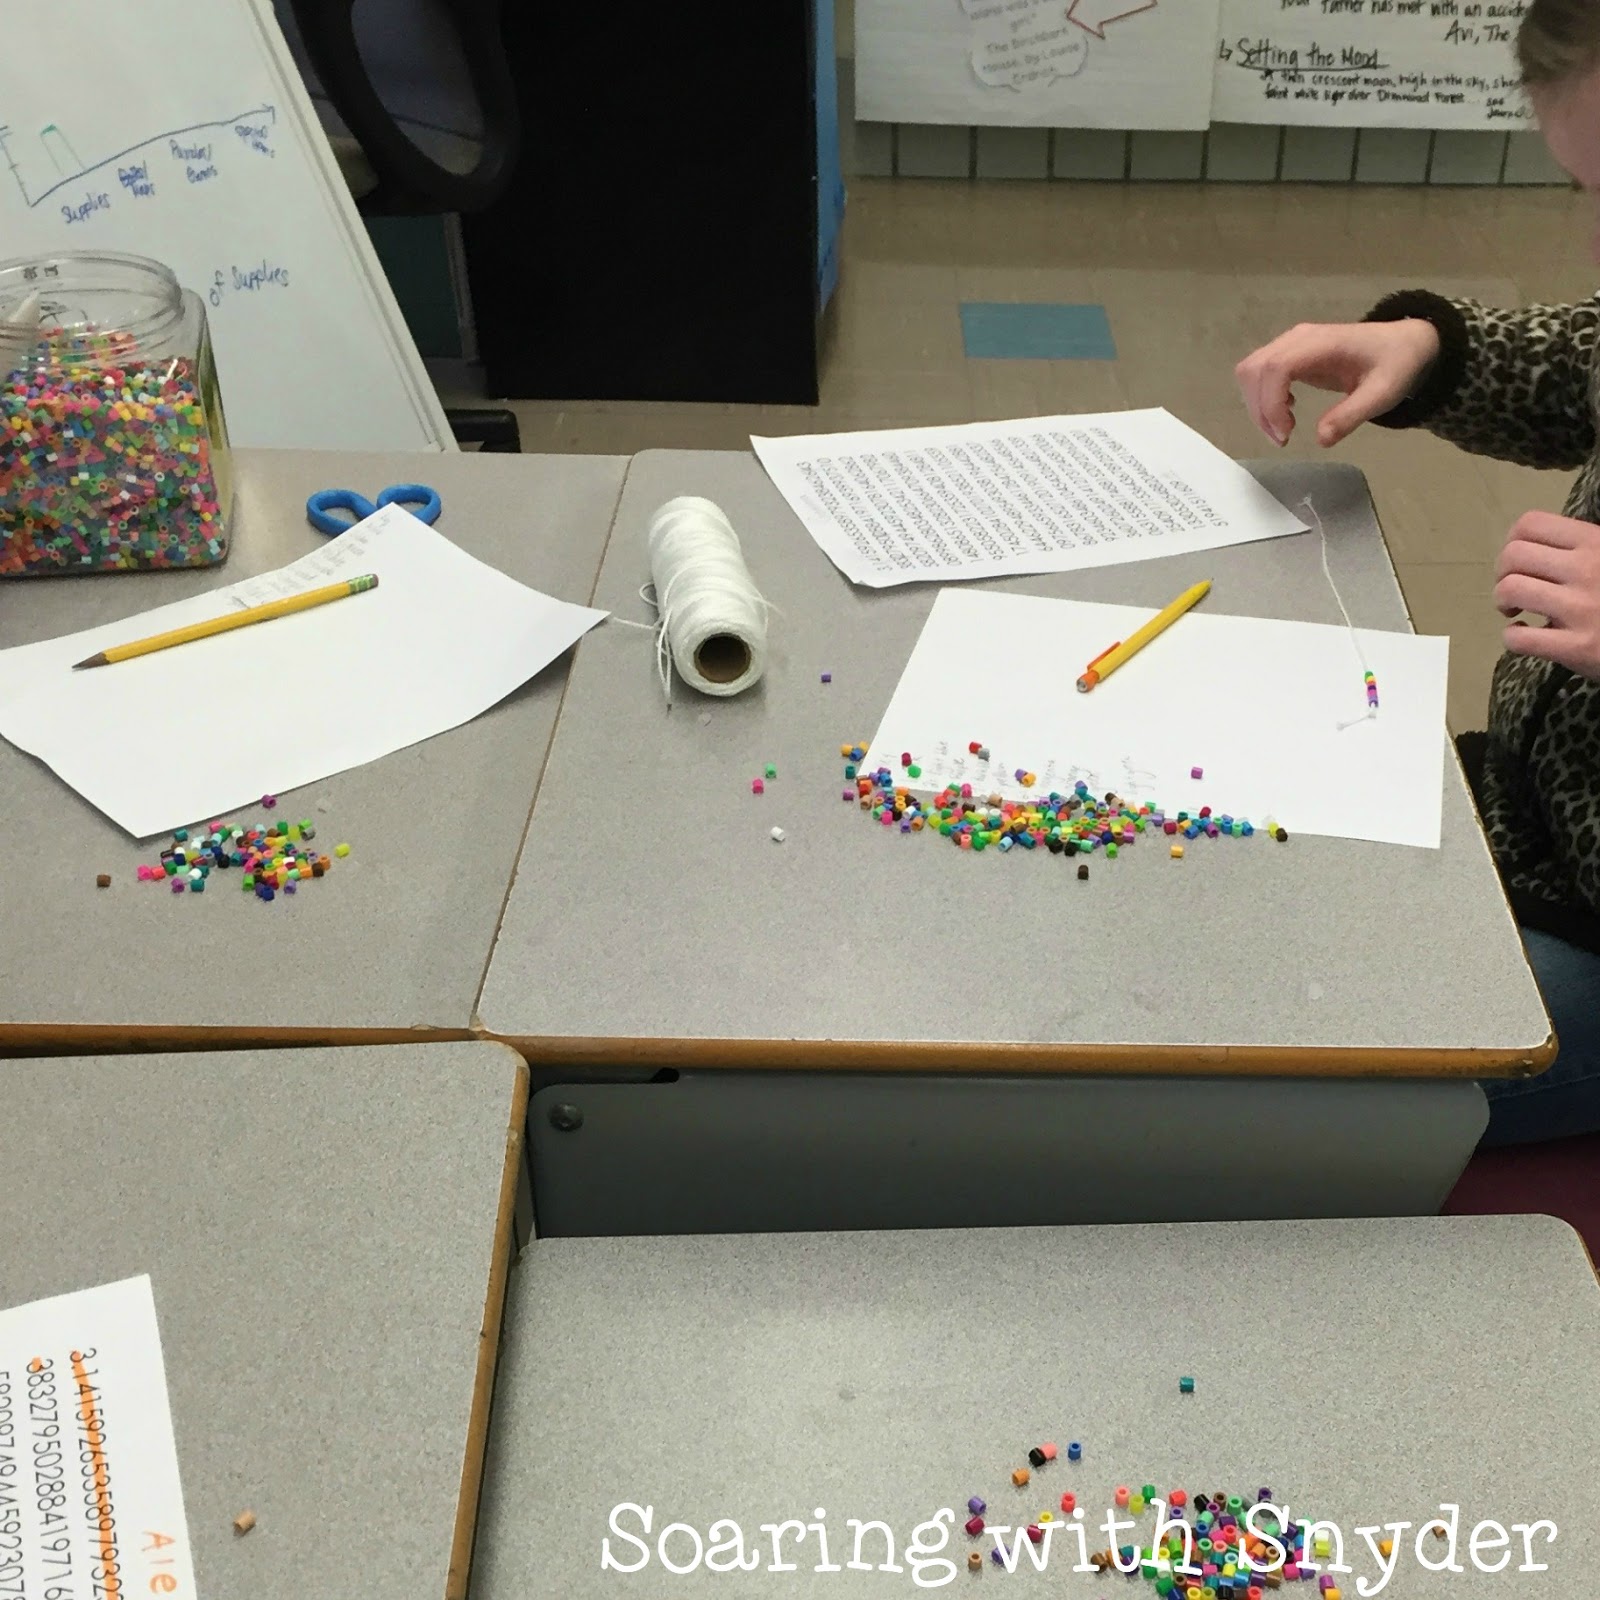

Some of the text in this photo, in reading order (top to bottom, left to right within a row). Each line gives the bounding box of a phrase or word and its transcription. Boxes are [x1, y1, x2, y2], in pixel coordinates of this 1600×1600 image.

[1371, 0, 1393, 15] has
[1430, 1, 1459, 17] with
[1464, 4, 1482, 17] an
[1483, 24, 1511, 42] The
[1236, 37, 1299, 75] Setting
[1305, 41, 1336, 66] the
[61, 191, 111, 224] Supplies
[231, 258, 290, 291] Supplies
[26, 1358, 75, 1600] 38327950288419716
